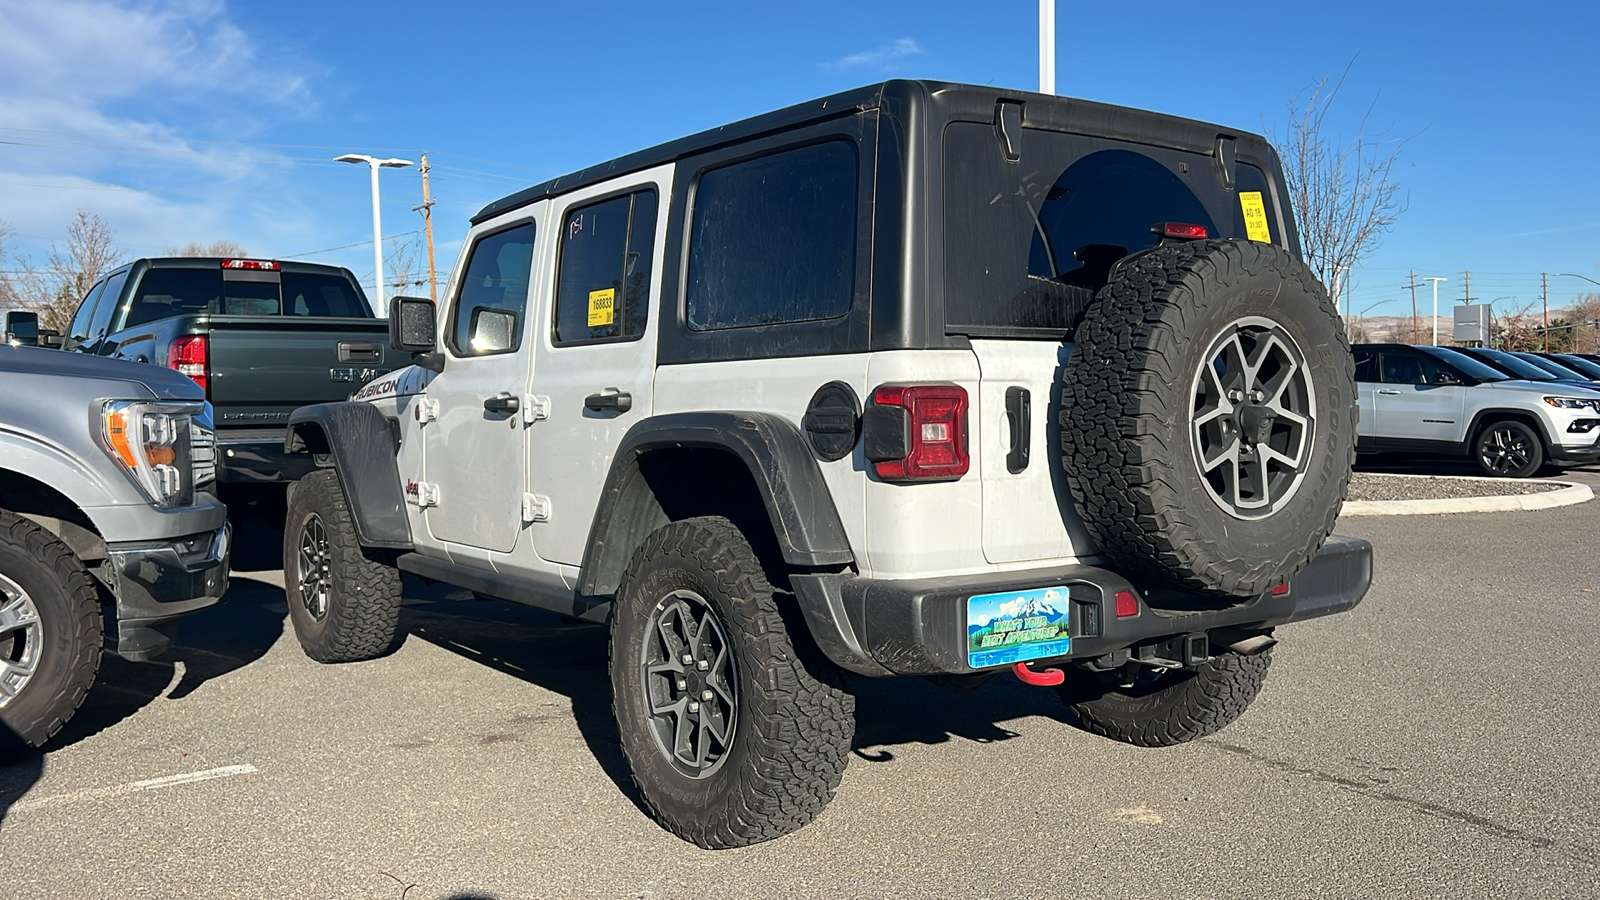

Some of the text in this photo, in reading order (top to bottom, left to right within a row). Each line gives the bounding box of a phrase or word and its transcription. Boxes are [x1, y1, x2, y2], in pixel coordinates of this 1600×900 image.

[593, 297, 613, 311] 168833
[356, 379, 398, 400] RUBICON
[994, 615, 1048, 633] WHAT'S YOUR
[981, 625, 1060, 648] NEXT ADVENTURE?
